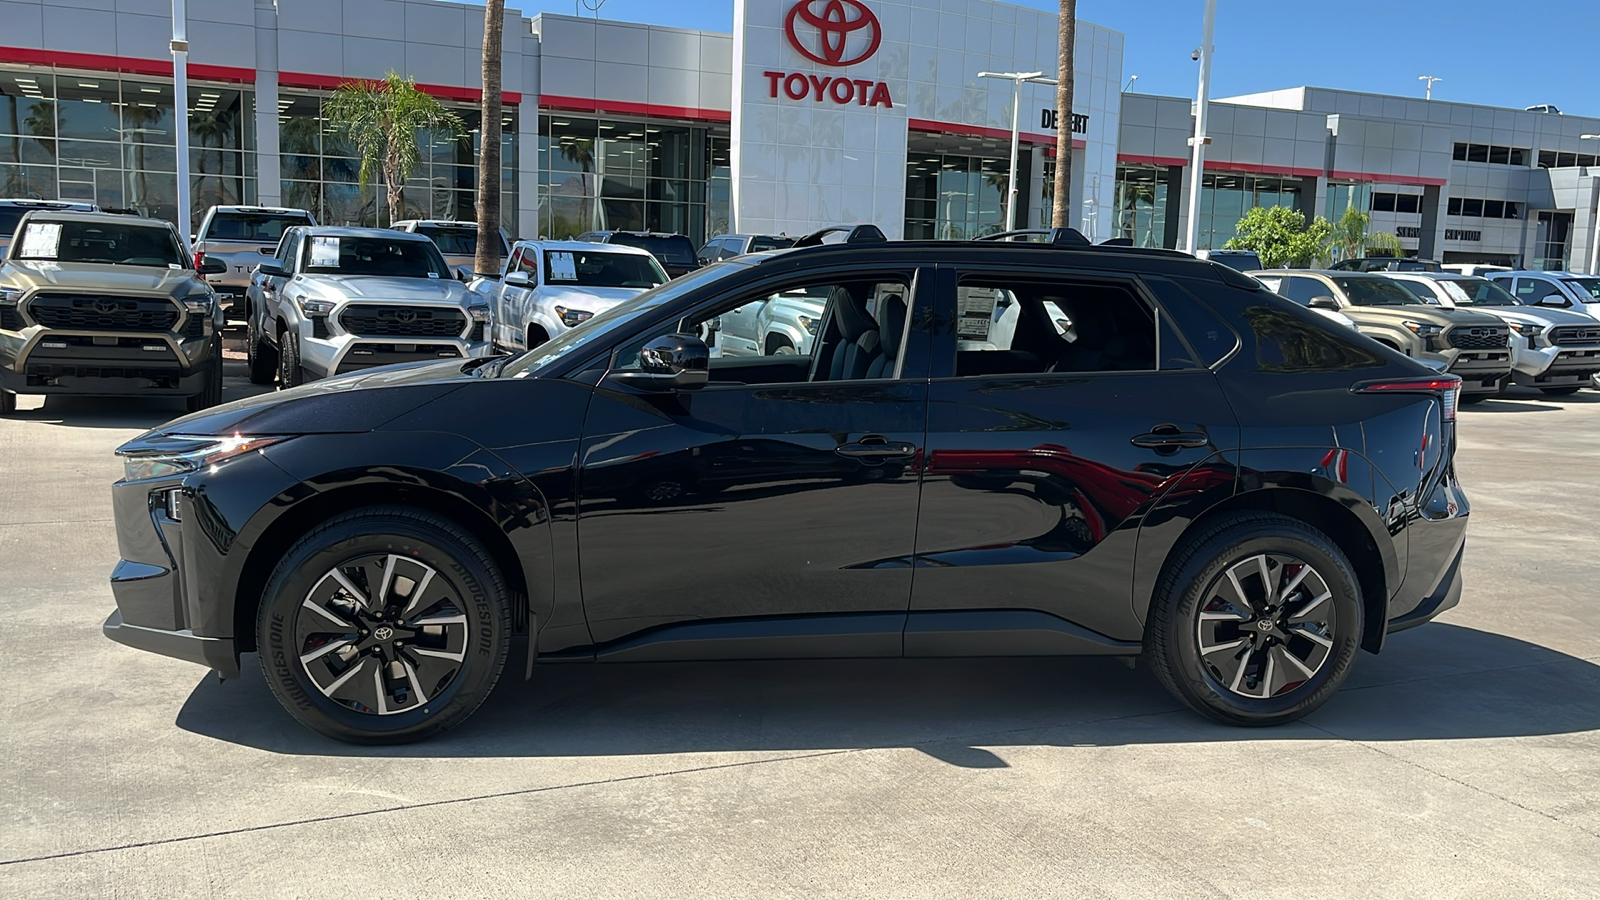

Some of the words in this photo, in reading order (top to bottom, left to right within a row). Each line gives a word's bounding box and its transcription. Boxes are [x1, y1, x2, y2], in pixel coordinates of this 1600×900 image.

[763, 71, 893, 108] TOYOTA
[1041, 108, 1090, 134] DEERT
[451, 562, 493, 658] BRIDGESTONE
[270, 611, 311, 712] BRIDGESTONE
